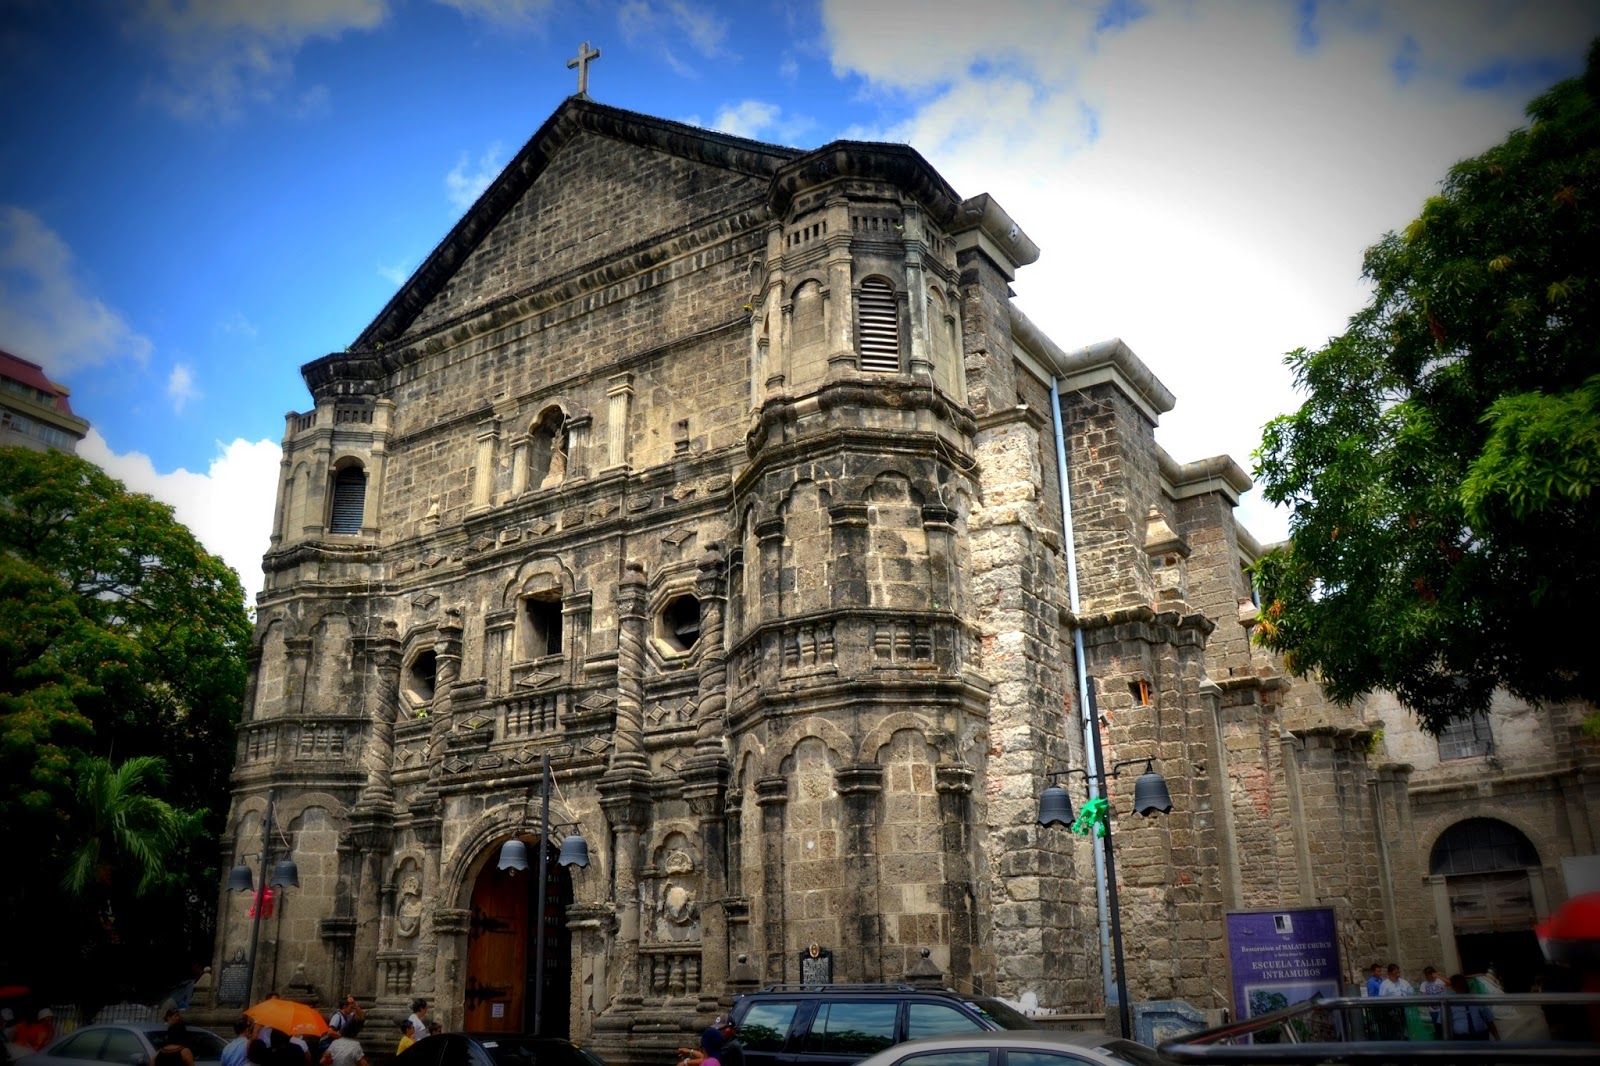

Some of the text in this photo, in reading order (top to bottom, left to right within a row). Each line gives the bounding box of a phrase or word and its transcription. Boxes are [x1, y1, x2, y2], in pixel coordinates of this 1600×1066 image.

[1252, 958, 1327, 969] ESCUELA TALLER
[1262, 969, 1320, 979] INTRAMUROS
